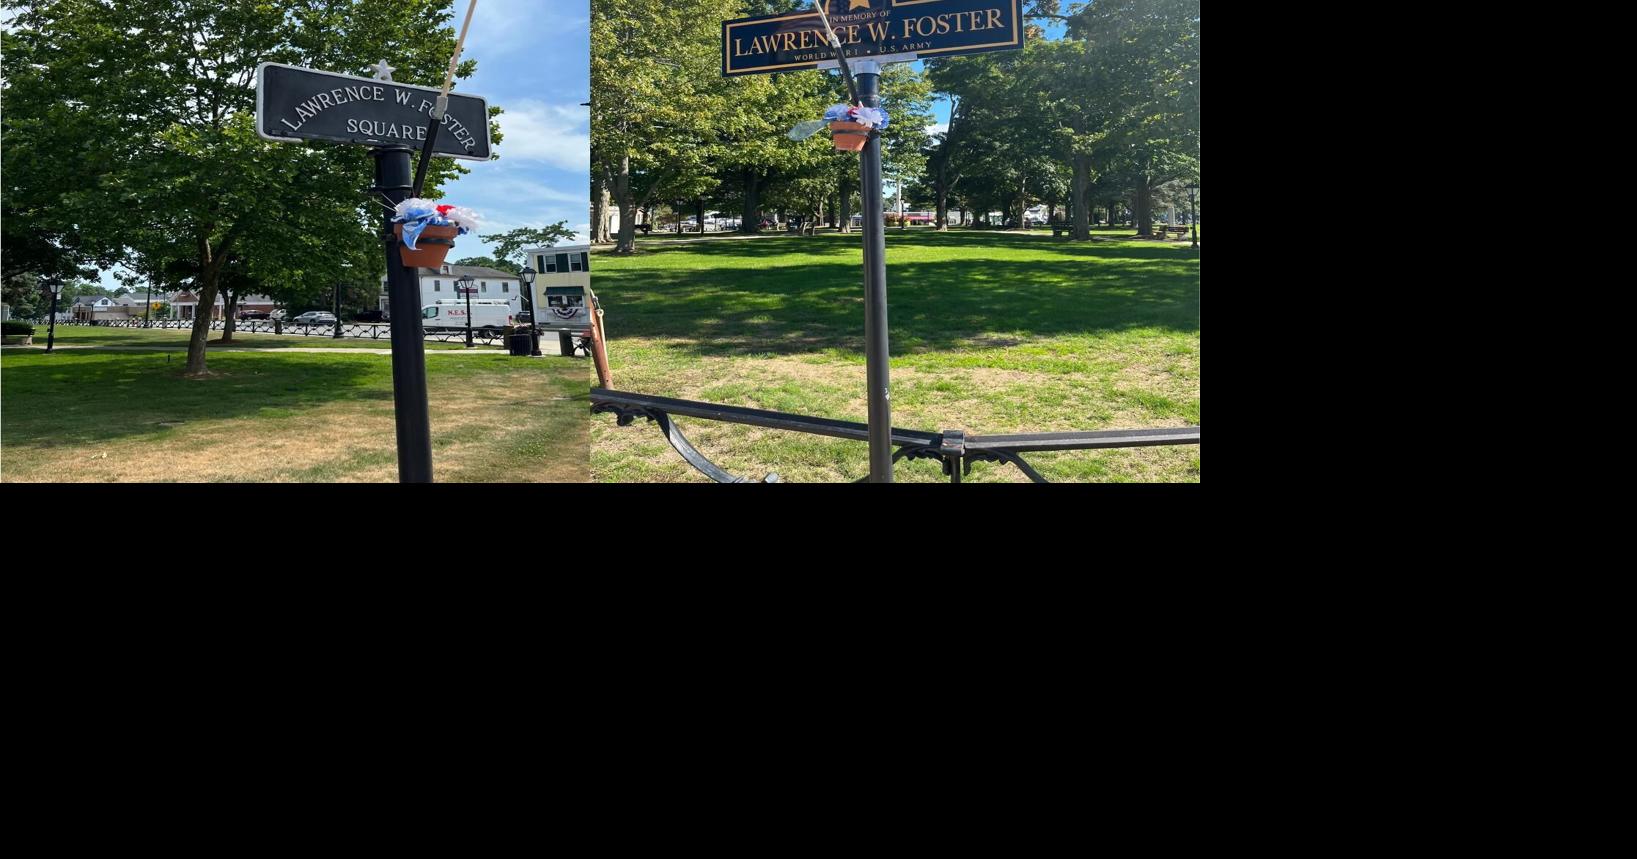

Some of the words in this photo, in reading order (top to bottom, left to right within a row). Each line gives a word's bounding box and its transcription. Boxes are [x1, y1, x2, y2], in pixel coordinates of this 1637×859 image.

[829, 16, 839, 24] IN
[840, 11, 877, 22] MEMORY
[879, 9, 892, 18] OF
[734, 24, 862, 57] LAWRENCE
[867, 20, 896, 43] W.
[903, 8, 1005, 39] FOSTER
[794, 52, 827, 62] WORLD
[830, 48, 854, 57] WR
[902, 41, 932, 52] ARMY
[281, 85, 385, 131] LAWRENCE
[394, 88, 415, 108] W.
[346, 119, 428, 141] SQUARE
